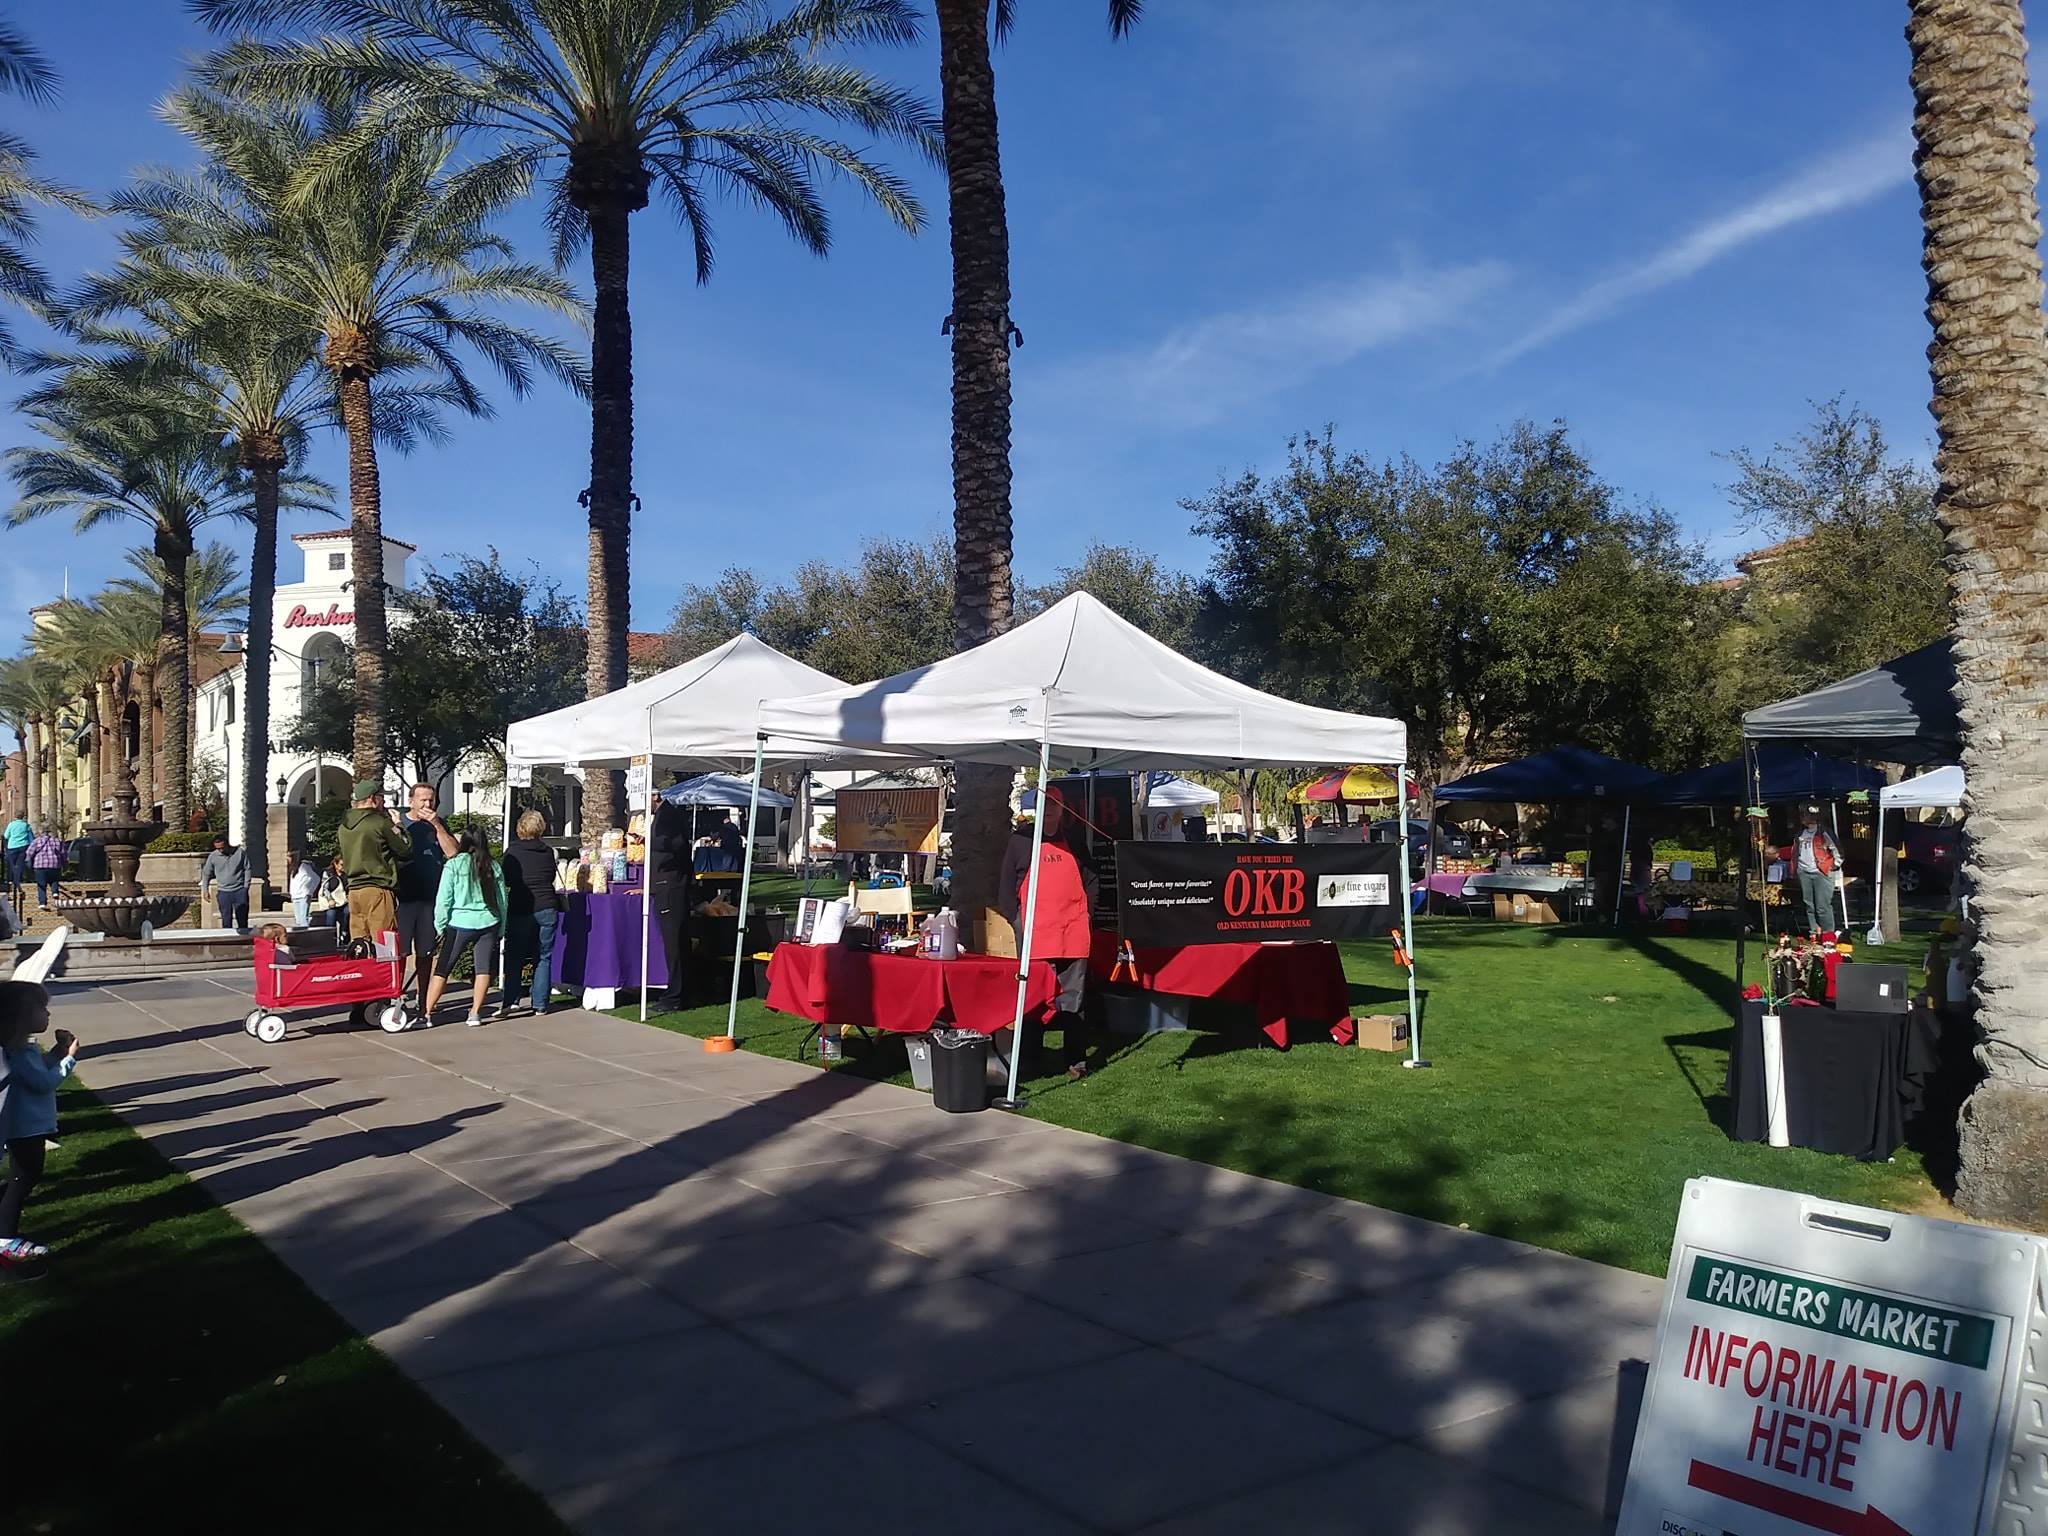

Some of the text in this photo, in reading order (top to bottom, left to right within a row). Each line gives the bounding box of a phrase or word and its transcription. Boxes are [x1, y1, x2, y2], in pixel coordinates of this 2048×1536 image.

[1043, 854, 1063, 863] OKB
[1236, 855, 1294, 864] HAVE YOU TRIED THE
[1165, 882, 1174, 890] my
[1224, 869, 1305, 916] OKB
[1157, 898, 1176, 908] unique
[1176, 896, 1186, 905] and
[1216, 918, 1312, 931] OLD KENTUCKY BARBEQUE SAUCE
[1706, 1267, 1961, 1356] FARMERS MARKET
[1683, 1325, 1962, 1451] INFORMATION
[1747, 1405, 1862, 1493] HERE
